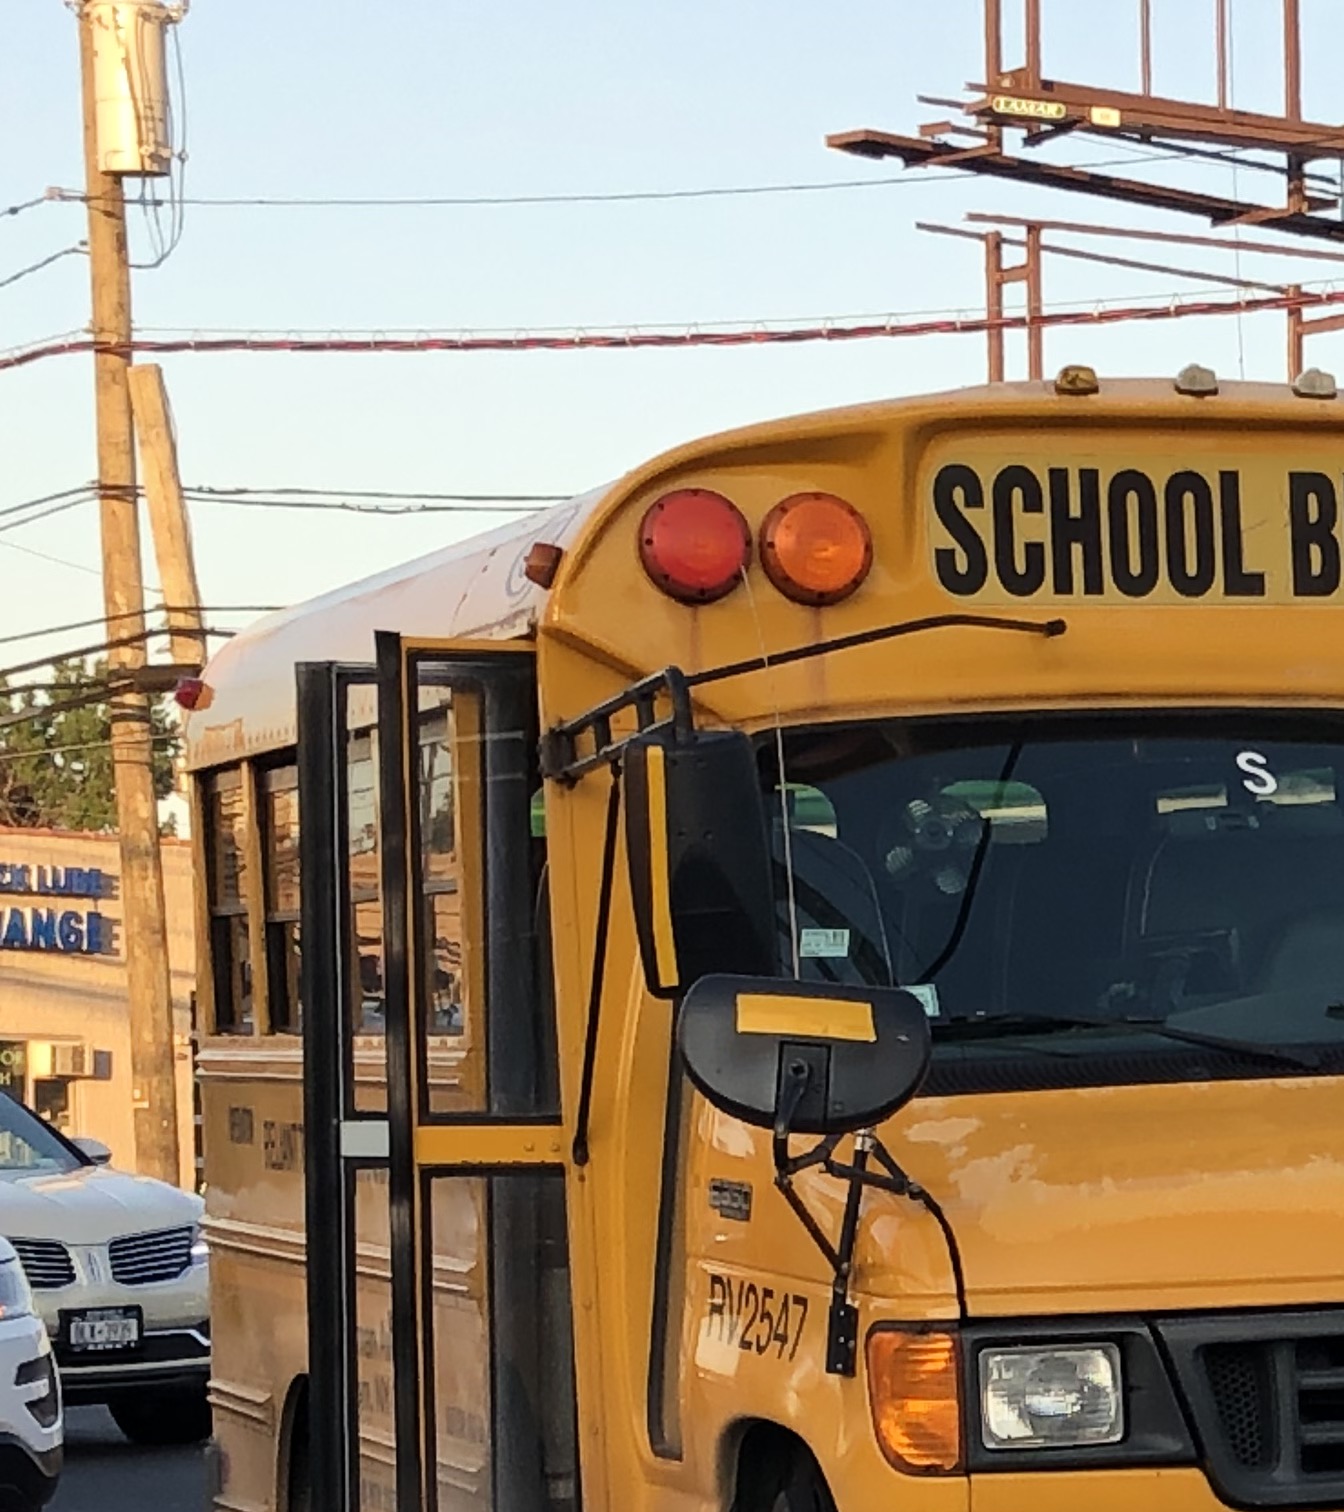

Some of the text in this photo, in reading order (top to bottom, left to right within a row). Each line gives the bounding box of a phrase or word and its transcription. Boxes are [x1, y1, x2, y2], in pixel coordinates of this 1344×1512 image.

[933, 464, 1265, 597] SCHOOL
[1236, 752, 1278, 795] S
[0, 907, 118, 955] ANGE
[706, 1274, 808, 1363] RV2547
